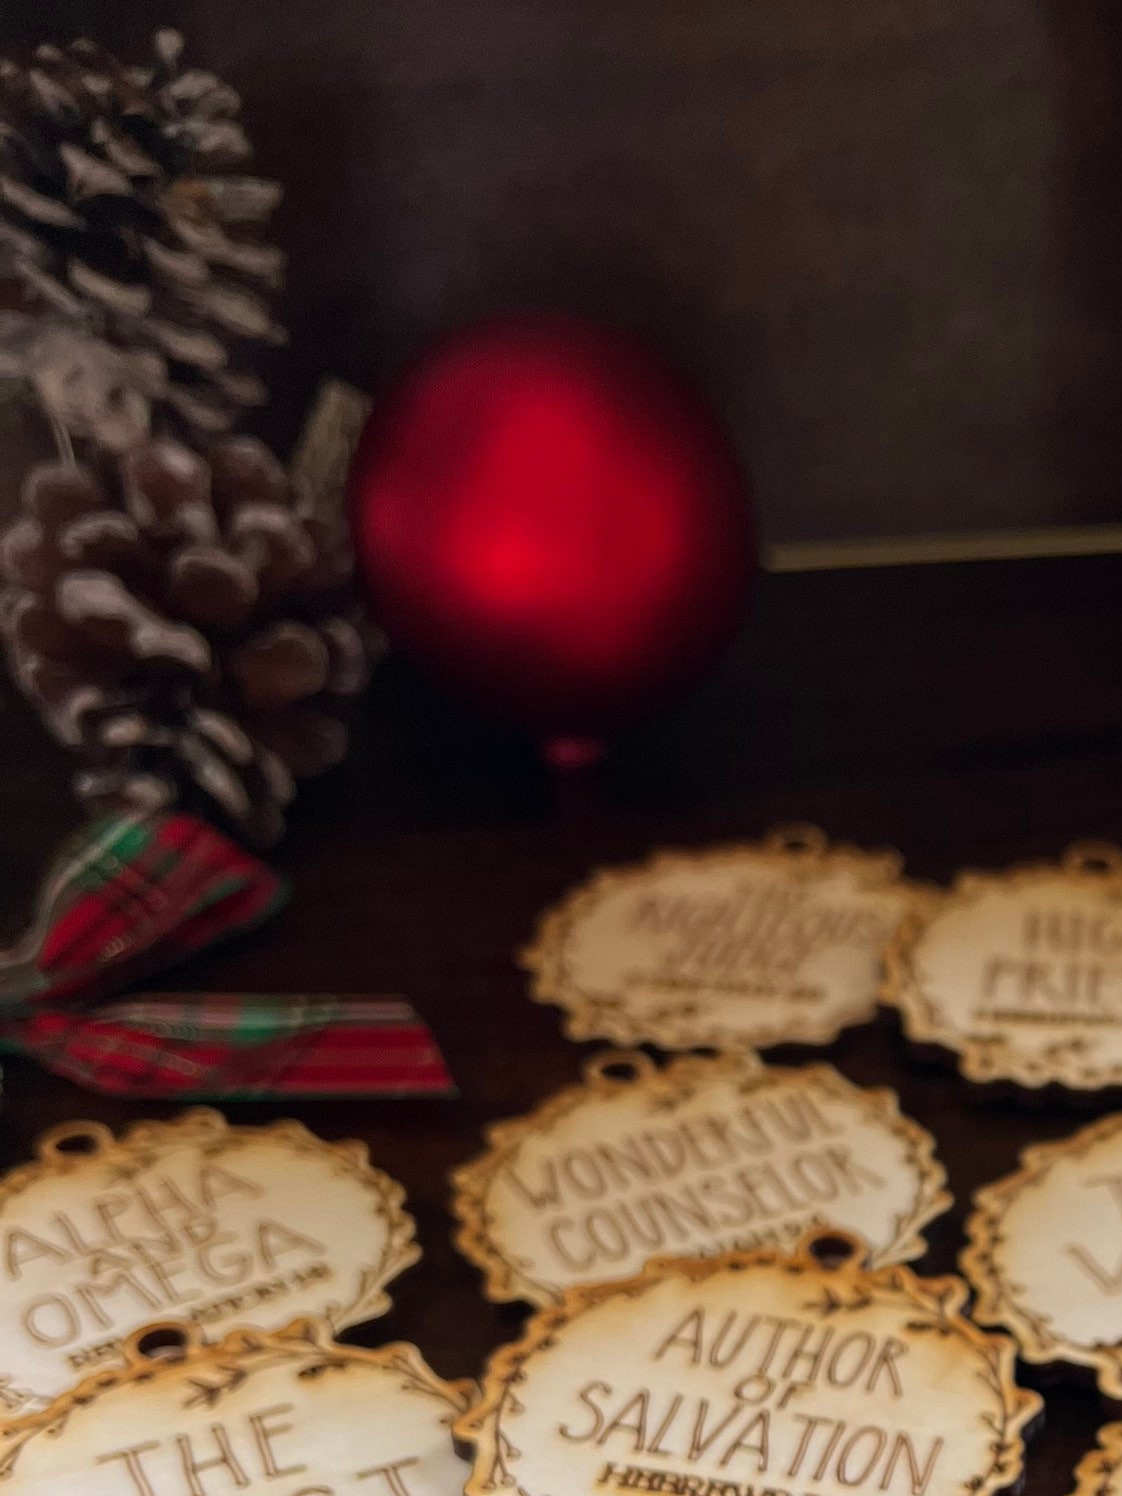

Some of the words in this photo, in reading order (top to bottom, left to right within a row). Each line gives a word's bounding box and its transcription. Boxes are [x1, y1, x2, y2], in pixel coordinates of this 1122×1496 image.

[505, 1092, 843, 1211] WONDERFUL
[548, 1144, 886, 1273] COUNSELOR
[4, 1164, 264, 1279] ALPHA
[22, 1217, 328, 1347] OMEGA
[655, 1304, 910, 1397] AUTHOR
[734, 1374, 816, 1409] OF
[558, 1380, 945, 1496] SALVATION
